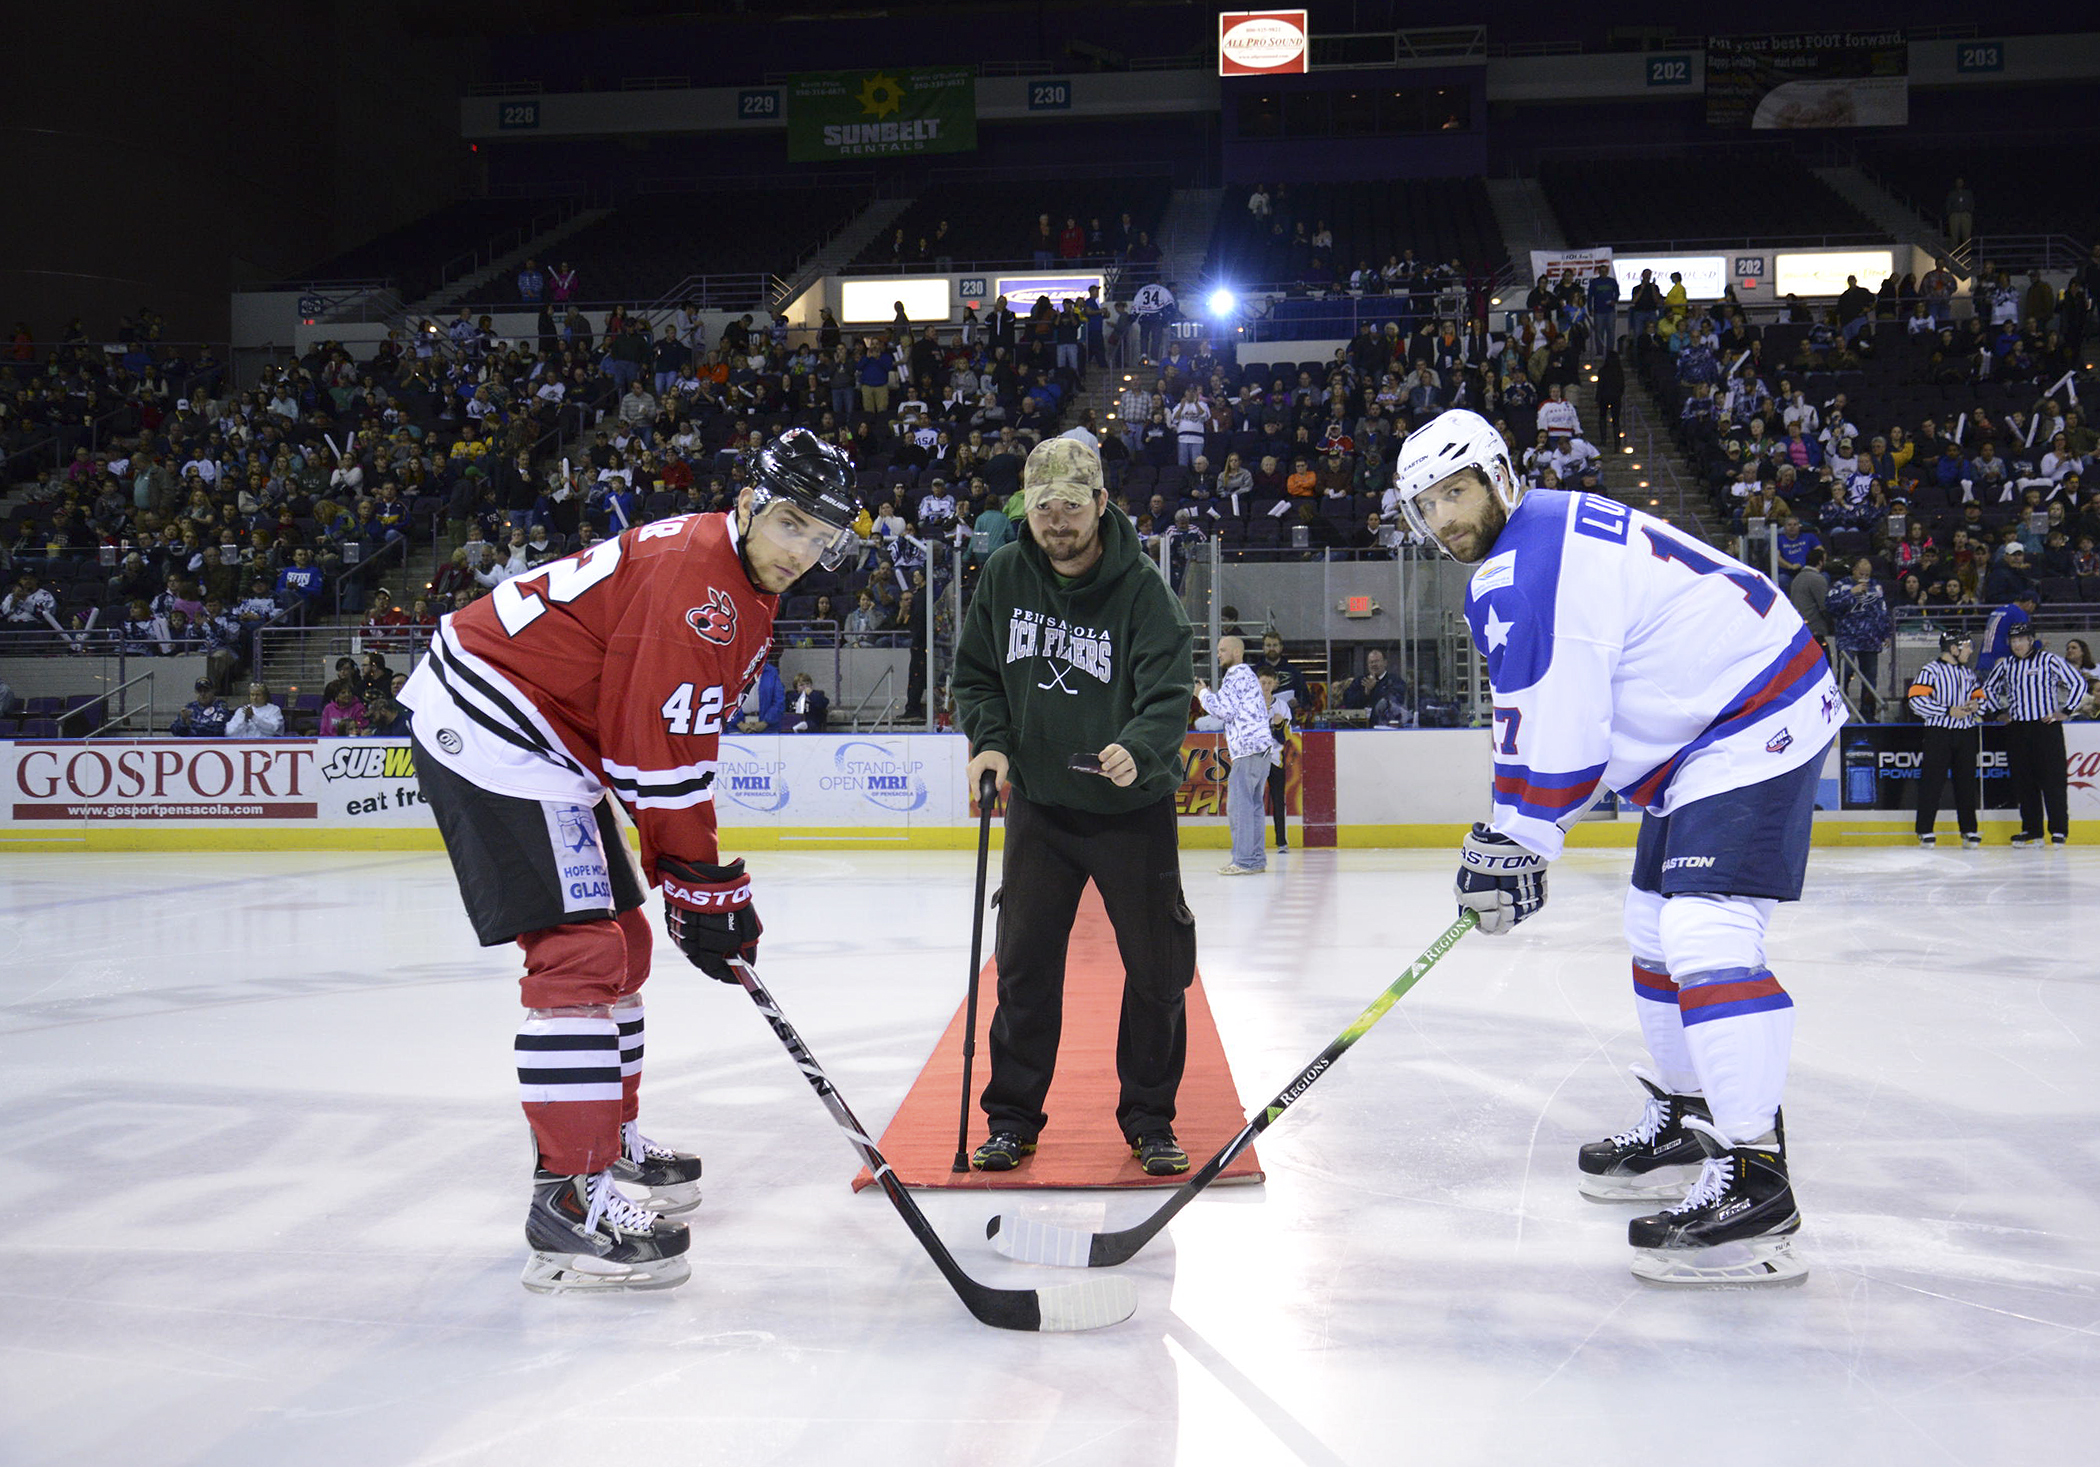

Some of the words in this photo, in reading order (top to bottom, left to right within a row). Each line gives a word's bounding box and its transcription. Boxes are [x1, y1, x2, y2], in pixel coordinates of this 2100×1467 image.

[1225, 38, 1246, 48] ALL
[1247, 37, 1267, 47] PRO
[1268, 36, 1303, 47] SOUND
[1709, 37, 1731, 49] Put
[1734, 40, 1769, 52] your
[1771, 36, 1801, 50] best
[1805, 34, 1841, 48] FOOT
[1963, 49, 1998, 68] 203
[1653, 62, 1686, 80] 202
[1034, 86, 1065, 104] 230
[744, 96, 774, 114] 229
[504, 106, 535, 125] 228
[824, 119, 940, 146] SUNBELT
[840, 142, 924, 155] RENTALS
[1738, 260, 1762, 274] 202
[961, 280, 984, 295] 230
[1143, 291, 1160, 305] 34
[1176, 322, 1198, 338] 101
[916, 436, 934, 445] USA
[1404, 455, 1429, 472] EASTON
[820, 494, 850, 512] BAUER
[1582, 492, 1628, 535] LU
[1641, 524, 1777, 620] 1
[492, 525, 623, 638] 2
[1012, 608, 1110, 640] PENSAOLA
[1007, 618, 1038, 664] ICE
[661, 682, 723, 735] 42
[1493, 707, 1522, 755] 7
[322, 747, 416, 782] SUBW
[847, 762, 923, 775] STAND-UP
[1879, 752, 2008, 768] POWDE
[16, 750, 314, 798] GOSPORT
[1879, 769, 1922, 779] POWE
[731, 777, 771, 790] MRI
[820, 777, 864, 791] OPEN
[868, 776, 907, 790] MRI
[347, 792, 388, 815] eat
[396, 788, 429, 807] fre
[68, 804, 263, 818] www.gosportpensacola.com
[1461, 846, 1540, 869] ASTON
[564, 865, 590, 878] HOPE
[570, 881, 610, 899] GLASS
[664, 879, 751, 906] EASTO
